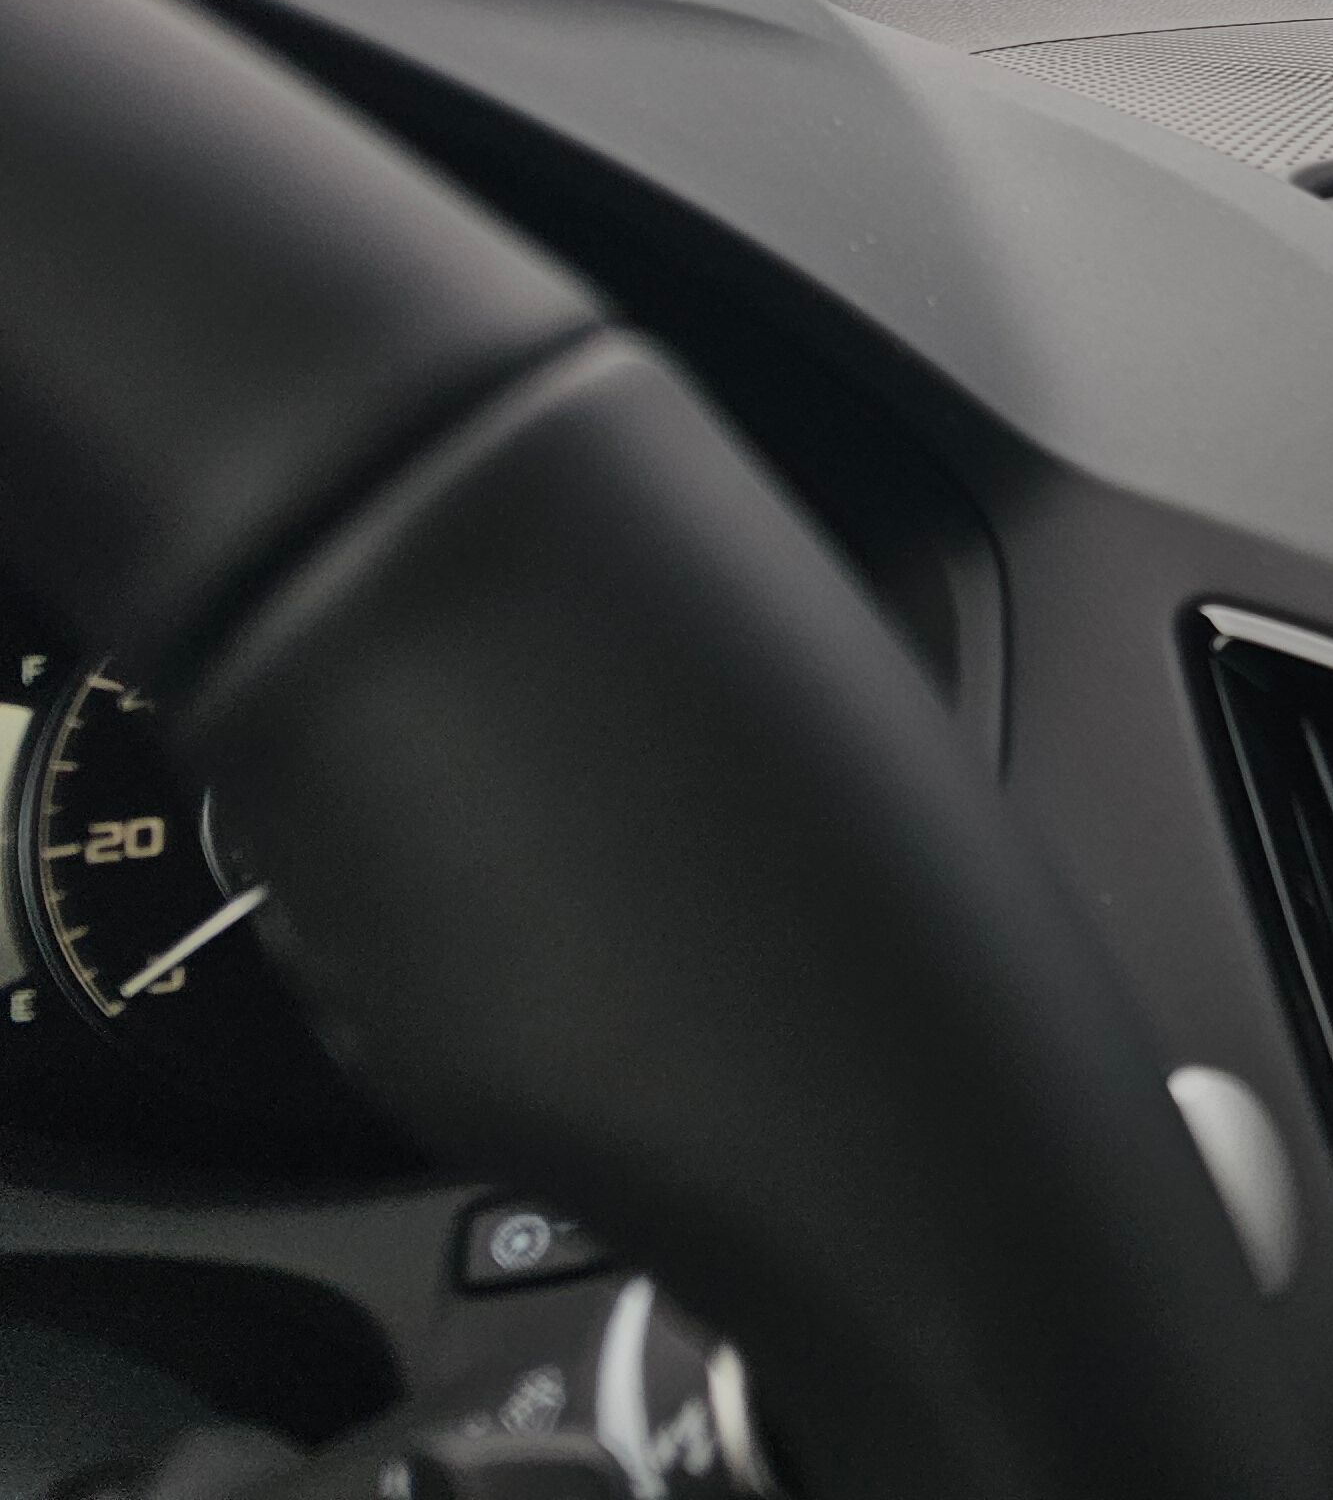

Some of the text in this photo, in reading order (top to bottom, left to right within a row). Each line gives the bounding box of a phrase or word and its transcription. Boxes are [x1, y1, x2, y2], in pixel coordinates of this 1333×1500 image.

[21, 654, 48, 688] F
[83, 816, 165, 865] 20
[10, 990, 36, 1023] E
